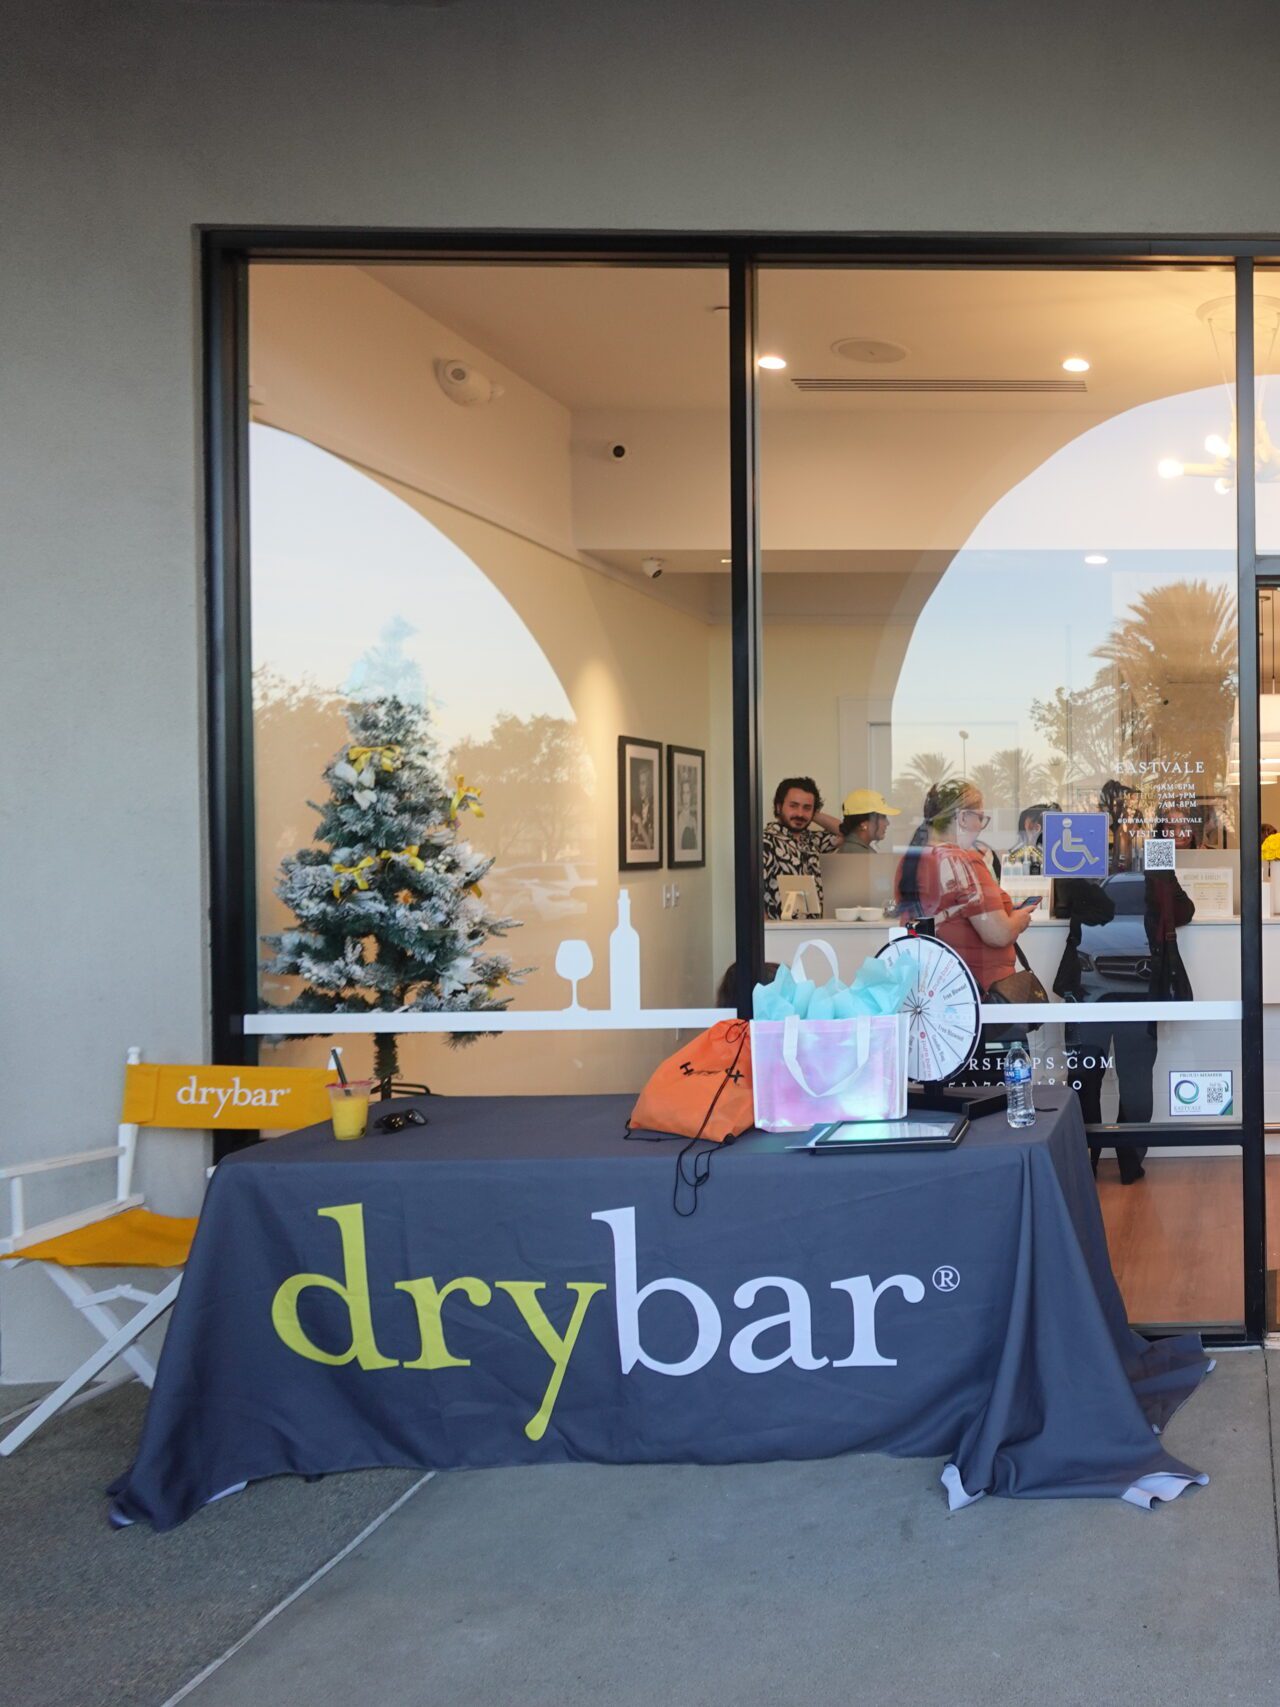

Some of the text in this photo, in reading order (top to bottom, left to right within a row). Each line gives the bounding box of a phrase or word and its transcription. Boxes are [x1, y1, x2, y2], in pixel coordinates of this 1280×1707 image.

[1115, 761, 1205, 773] EASTVALE
[1179, 829, 1192, 837] AT
[176, 1075, 291, 1118] drybar
